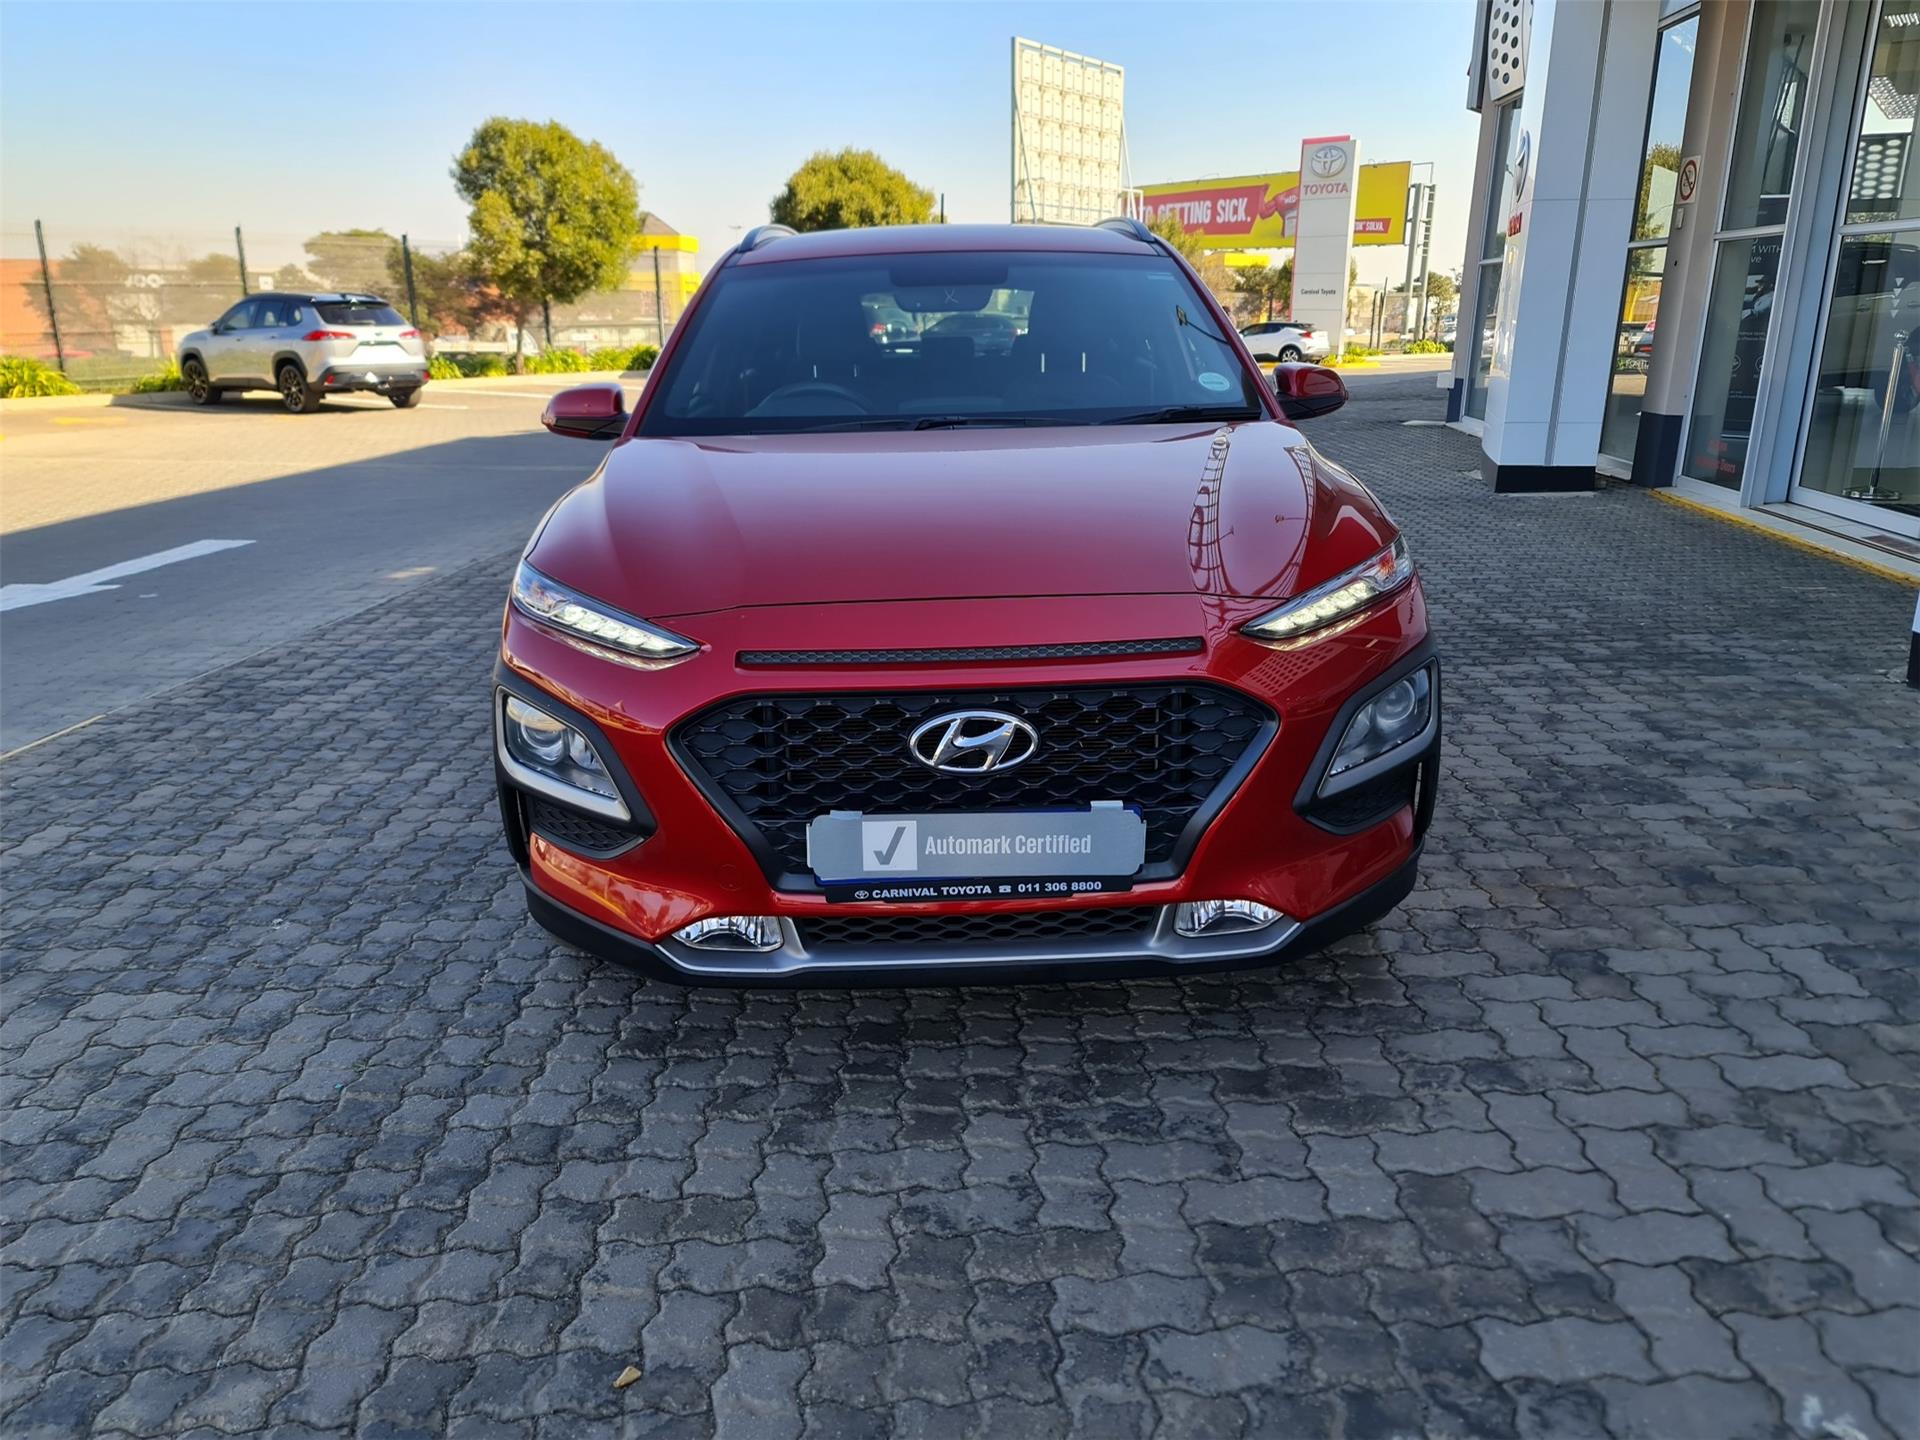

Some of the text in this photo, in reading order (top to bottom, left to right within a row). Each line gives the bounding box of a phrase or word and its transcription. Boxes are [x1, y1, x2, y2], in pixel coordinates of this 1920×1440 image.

[1303, 182, 1349, 196] TOYOTA
[1216, 197, 1251, 223] SICK.
[1321, 288, 1336, 296] Toyota
[925, 833, 1092, 856] Automark Certified
[872, 881, 1102, 899] CARNIVAL TOYOTA 011 306 8800
